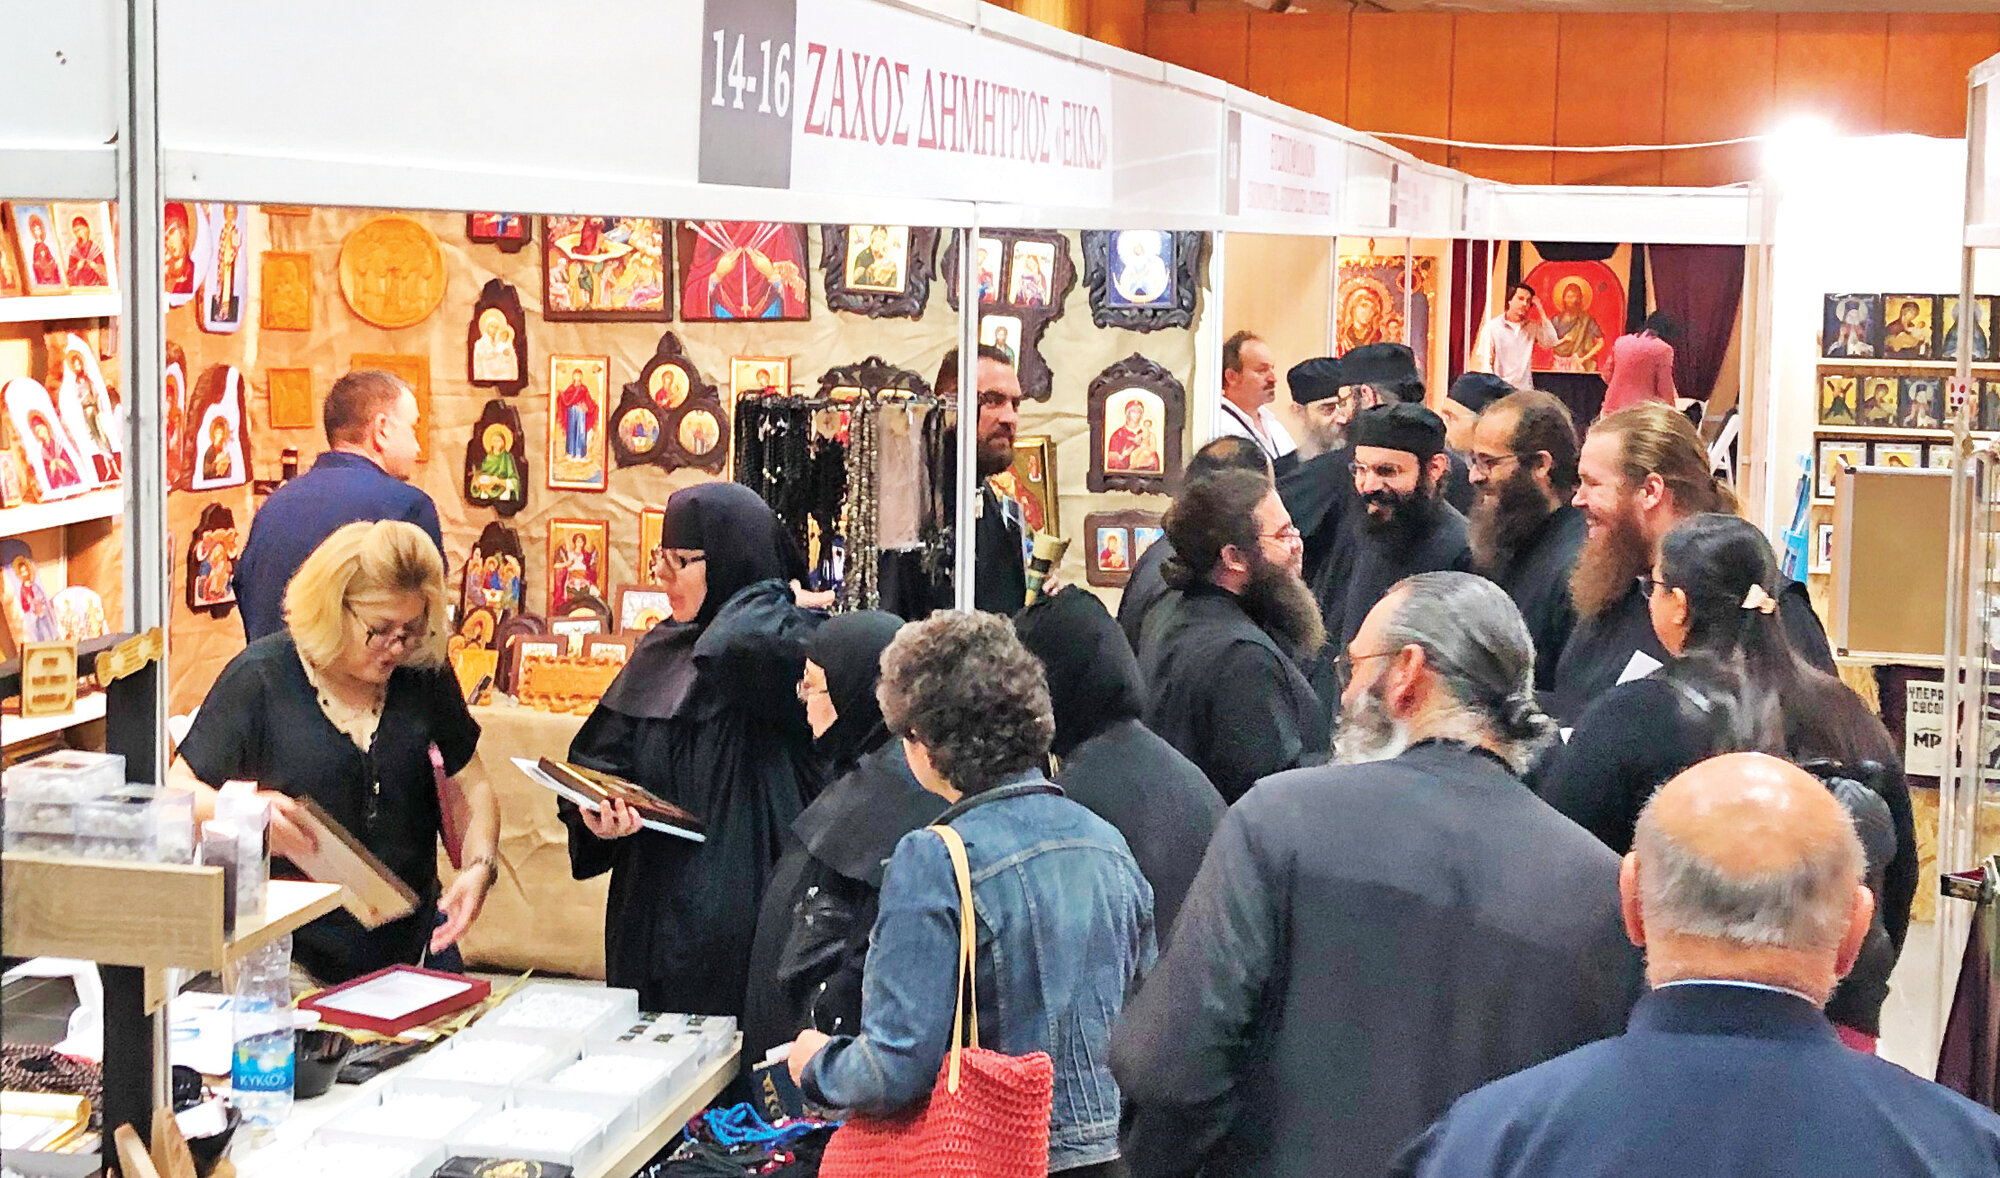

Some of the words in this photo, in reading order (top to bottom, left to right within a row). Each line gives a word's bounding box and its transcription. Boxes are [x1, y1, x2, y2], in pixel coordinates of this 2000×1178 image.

[711, 29, 791, 118] 14-16
[804, 42, 910, 146] ΖΑΧΟΣ
[918, 68, 1050, 164] ΔΗΜΗΤΡΙΟΣ
